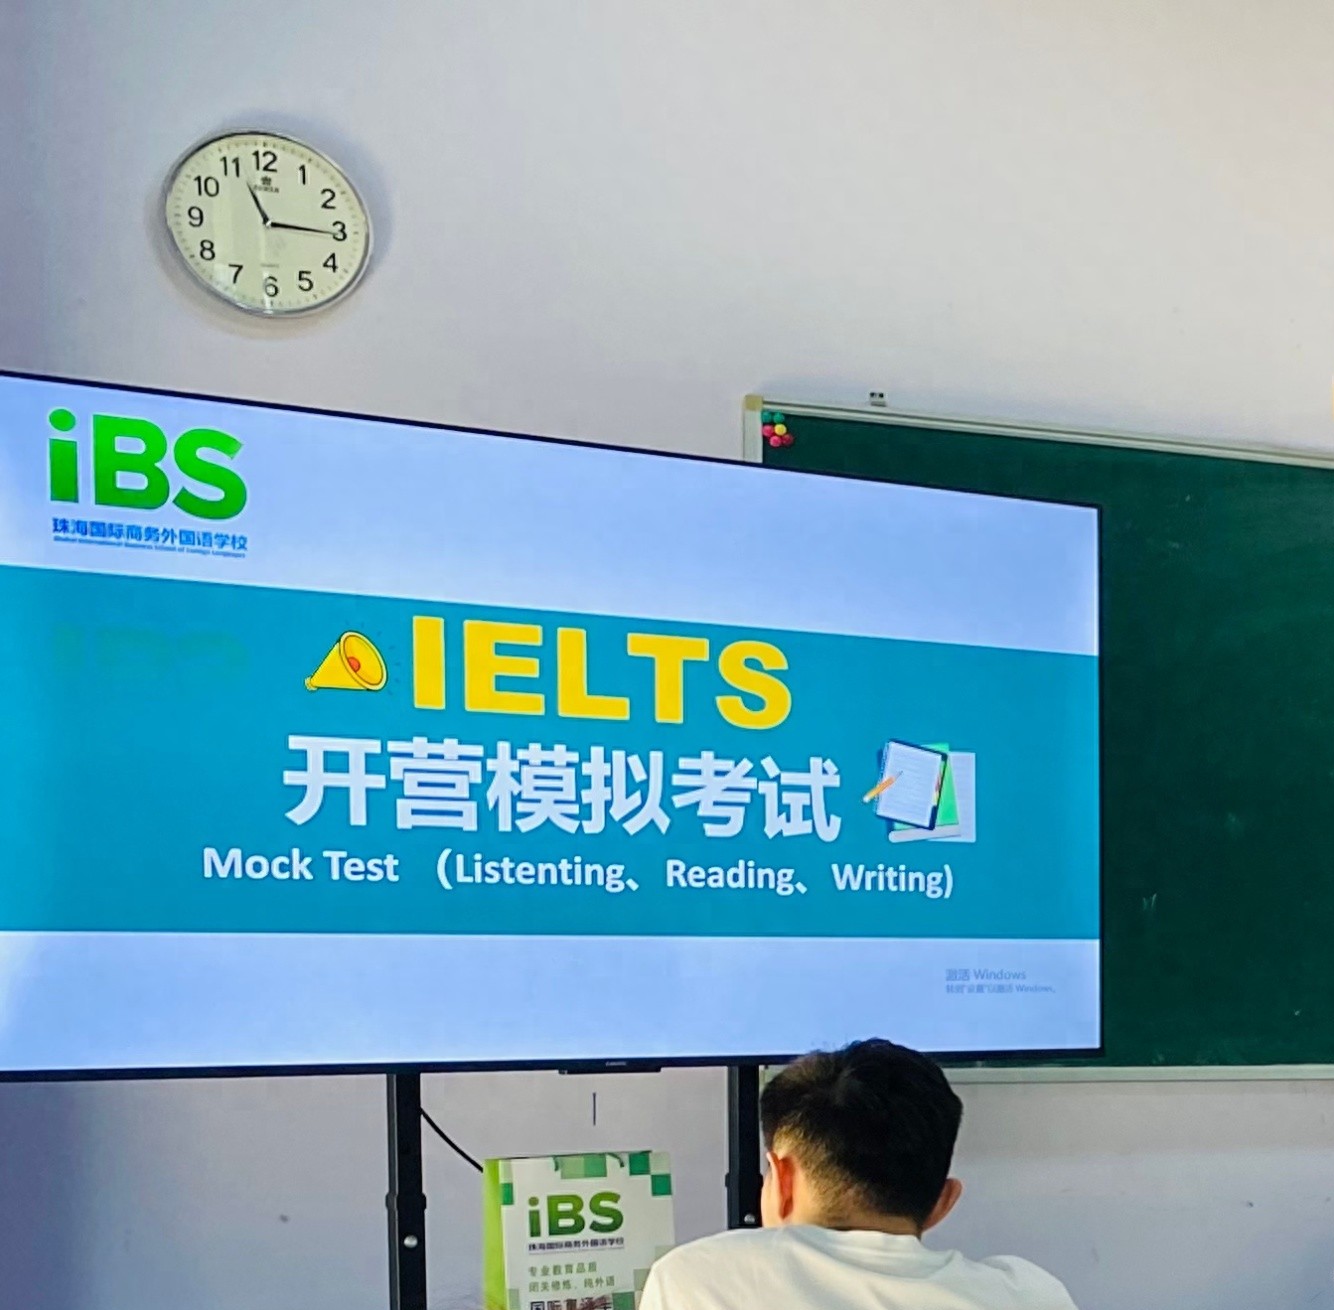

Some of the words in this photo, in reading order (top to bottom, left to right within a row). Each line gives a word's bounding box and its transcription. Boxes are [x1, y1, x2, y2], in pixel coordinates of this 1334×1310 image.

[220, 156, 240, 178] 11
[252, 150, 278, 172] 12
[298, 164, 307, 185] 1
[194, 175, 220, 197] 10
[320, 188, 336, 209] 2
[188, 206, 204, 228] 9
[331, 220, 347, 241] 3
[199, 240, 215, 261] 8
[228, 264, 243, 284] 7
[322, 253, 339, 273] 4
[264, 276, 279, 297] 6
[298, 270, 313, 292] 5
[48, 408, 248, 520] iBS
[411, 615, 793, 730] IELTS
[282, 735, 842, 844] 开营模拟考试
[203, 847, 313, 880] Mock
[322, 850, 400, 882] Test
[831, 863, 953, 898] Writing)
[973, 968, 1027, 981] Windows
[528, 1191, 625, 1238] iBS
